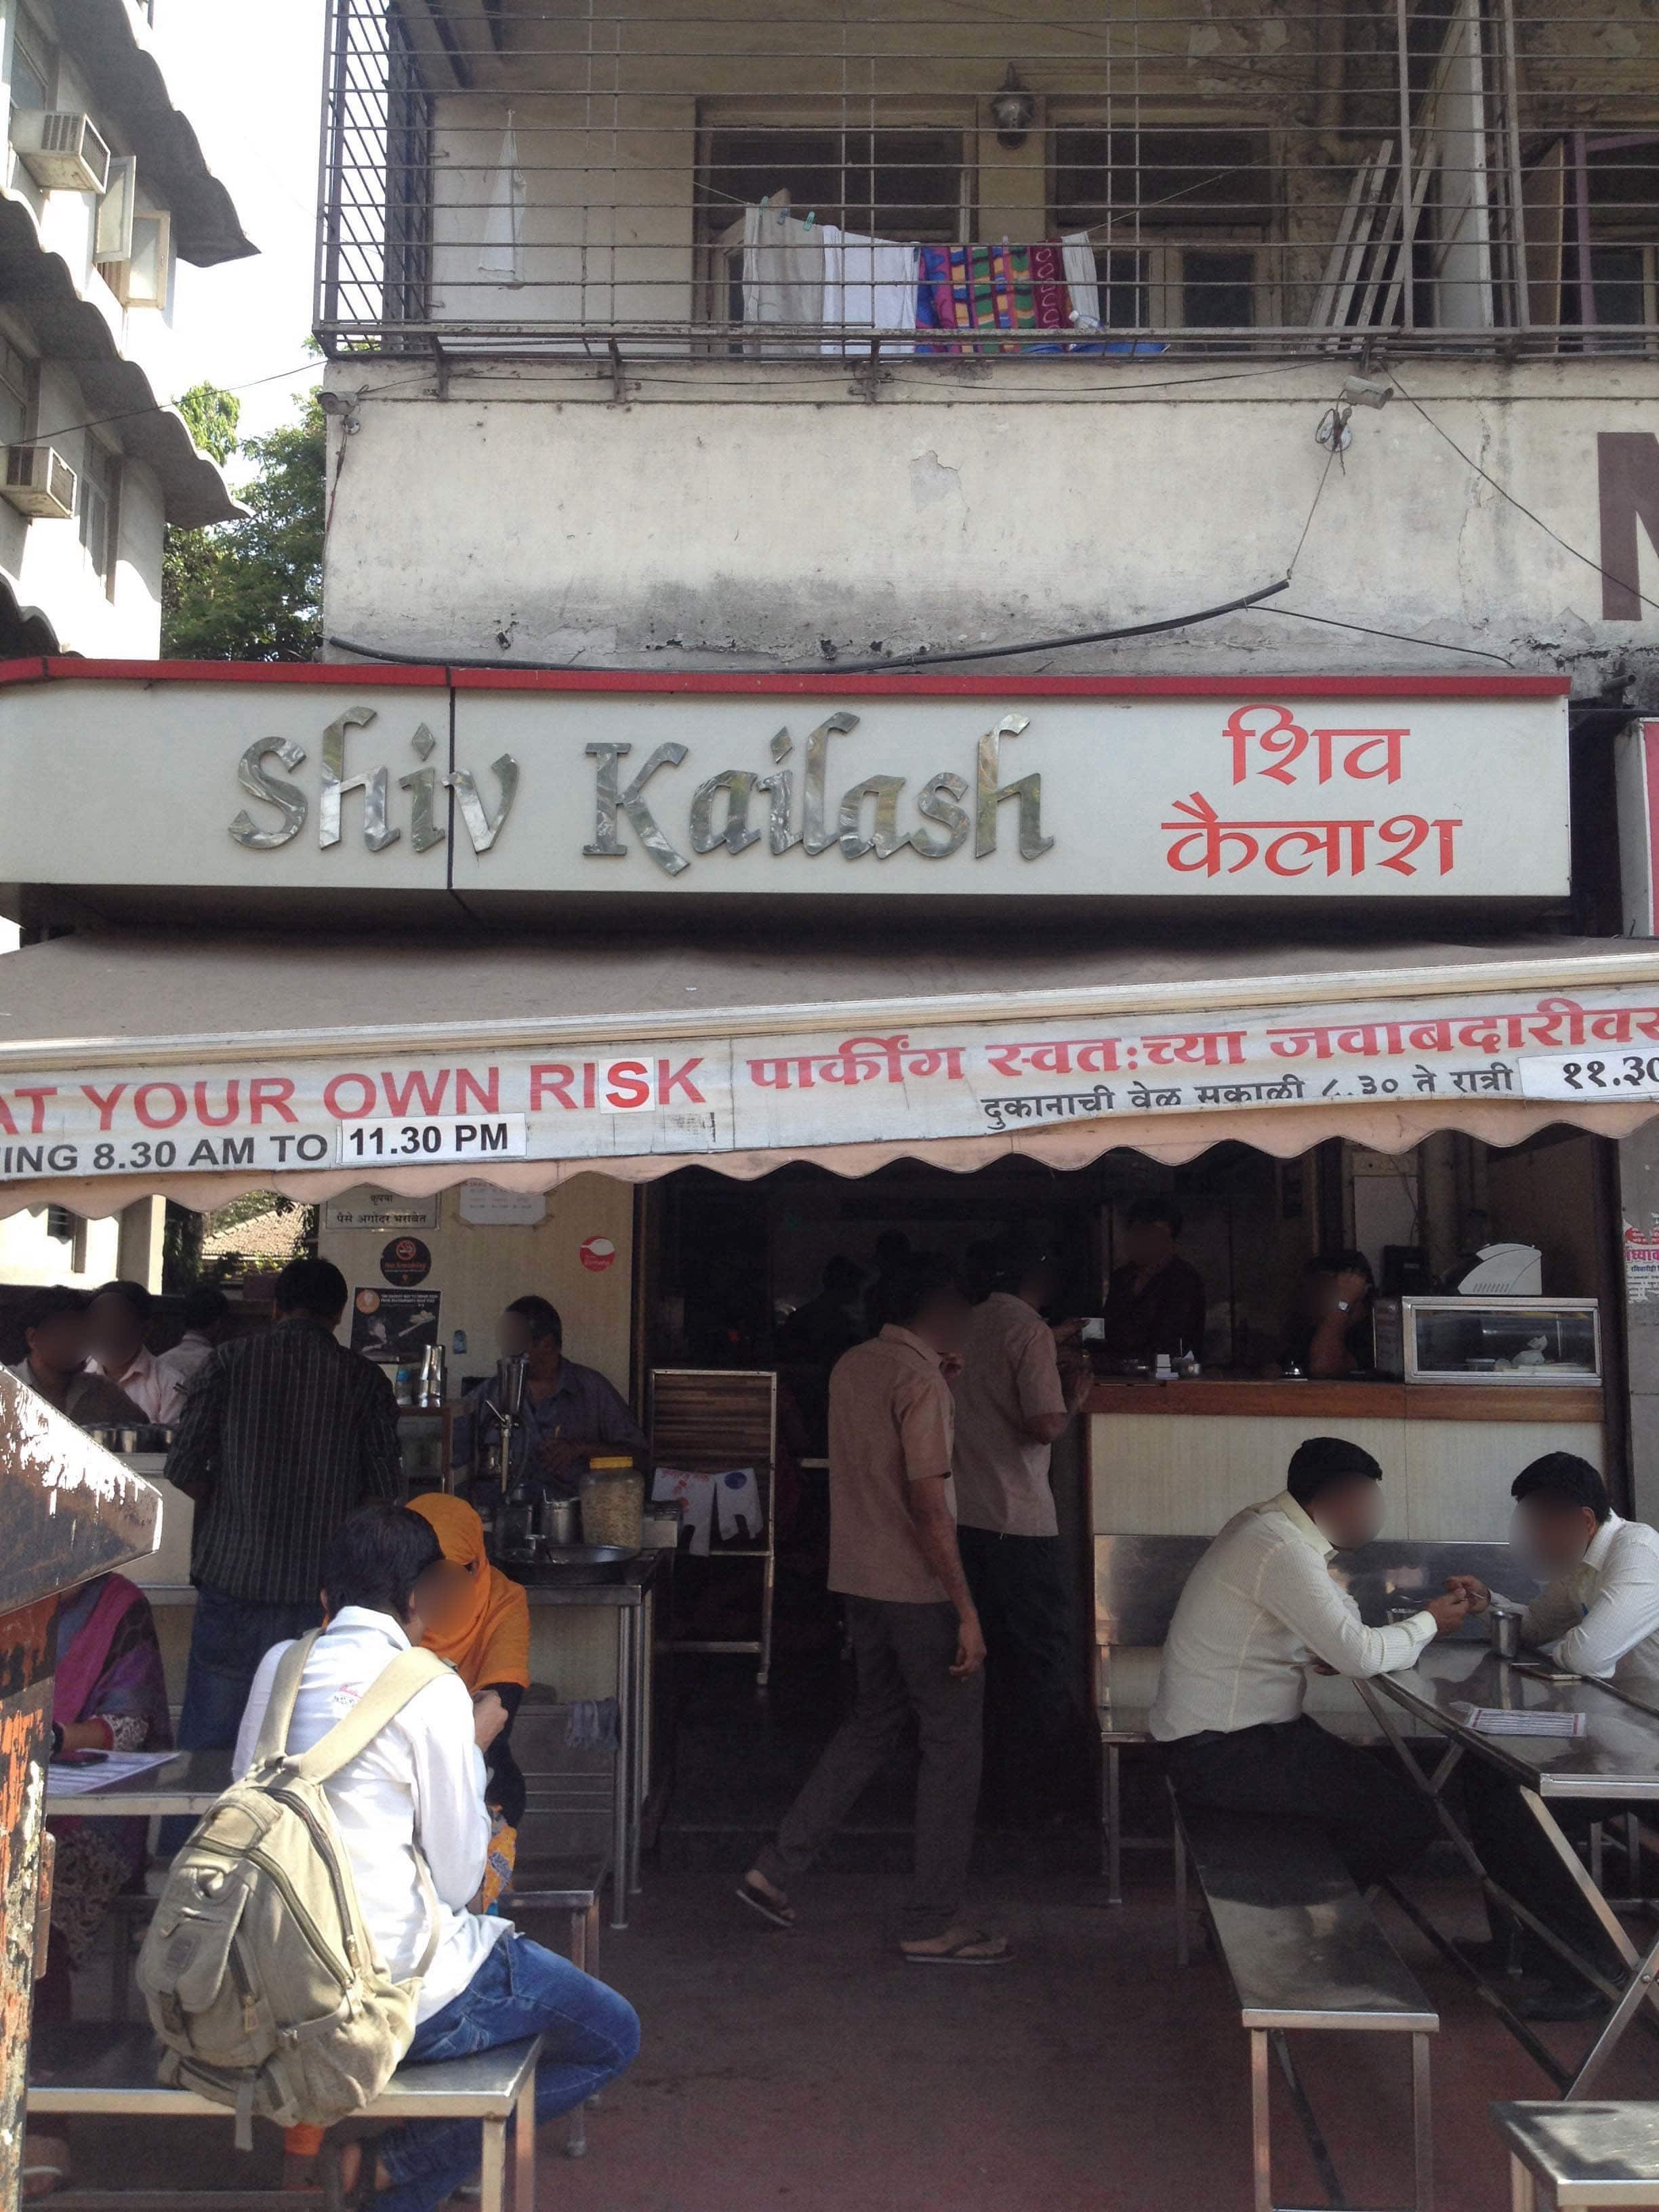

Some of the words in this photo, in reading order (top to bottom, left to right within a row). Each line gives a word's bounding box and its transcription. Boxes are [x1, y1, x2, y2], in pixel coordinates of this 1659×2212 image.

[1222, 703, 1411, 786] शिव
[228, 705, 520, 854] Shiv
[582, 711, 1054, 877] Kailash
[1160, 791, 1463, 878] कैलाश
[80, 1077, 300, 1131] YOUR
[323, 1066, 500, 1120] OWN
[529, 1057, 707, 1111] RISK
[980, 1084, 1116, 1130] दुकानाची
[1127, 1080, 1183, 1109] वेळ
[1412, 1063, 1437, 1093] ते
[1449, 1061, 1514, 1094] रात्री
[0, 1144, 78, 1174] ING
[92, 1141, 178, 1170] 8.30
[187, 1136, 255, 1166] AM
[269, 1133, 329, 1163] TO
[349, 1125, 442, 1155] 11.30
[455, 1122, 508, 1152] PM
